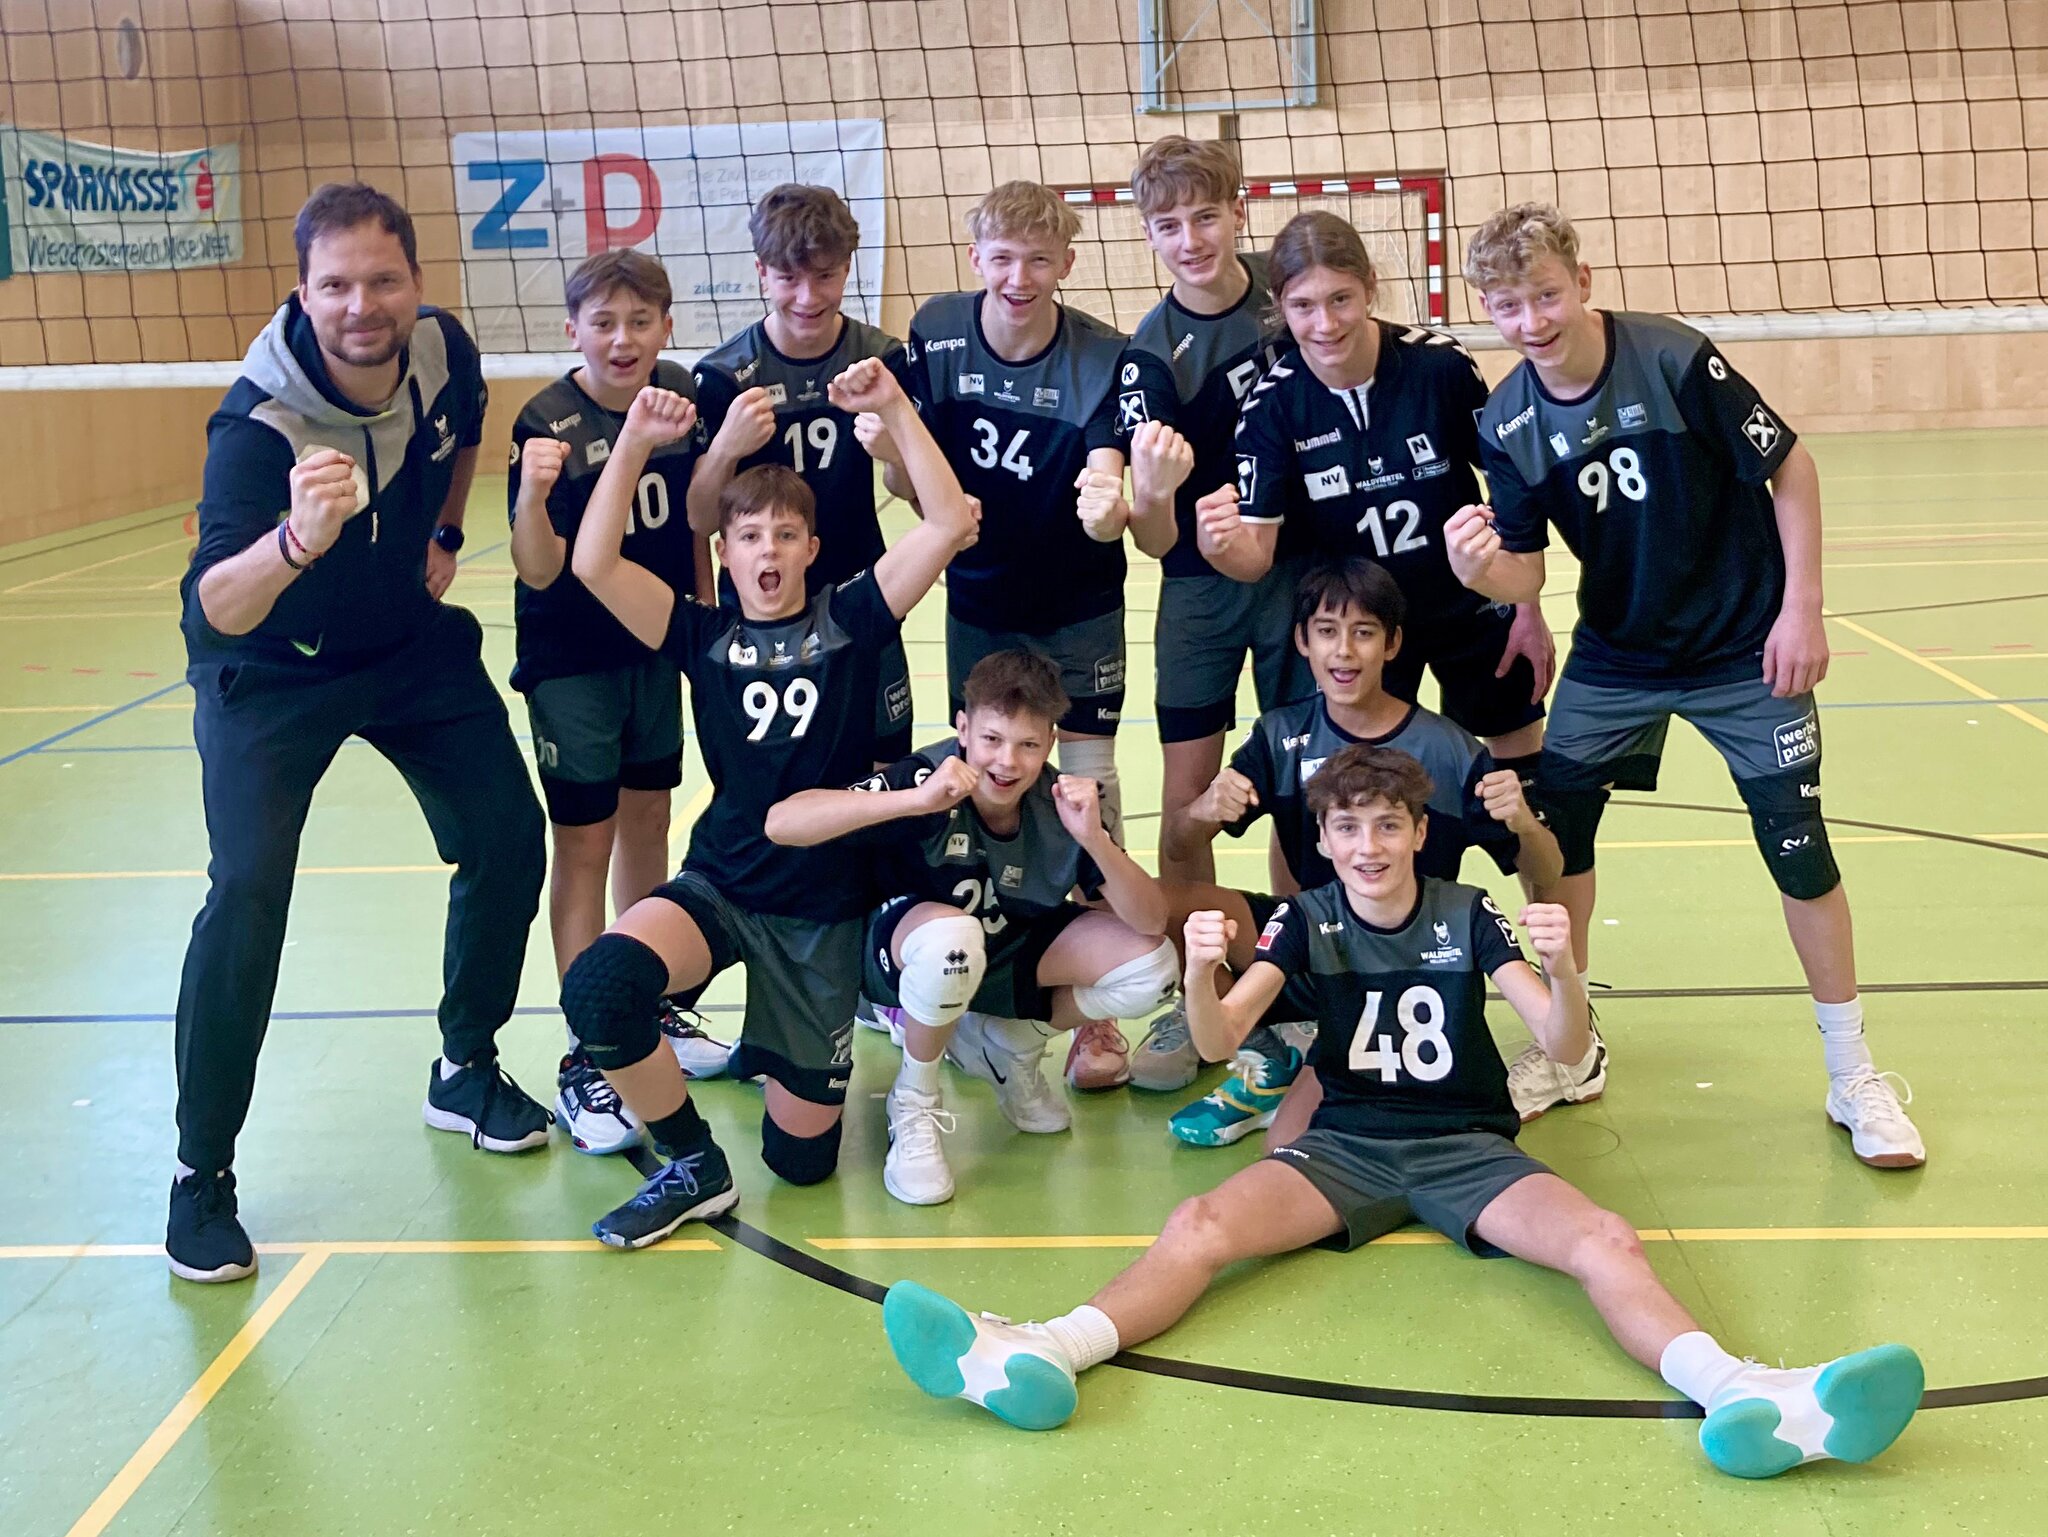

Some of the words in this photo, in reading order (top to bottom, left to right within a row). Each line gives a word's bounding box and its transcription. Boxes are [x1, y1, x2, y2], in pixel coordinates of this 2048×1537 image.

[25, 159, 180, 211] SPARKASSE
[924, 337, 966, 352] Kempa
[769, 388, 782, 397] NV
[969, 376, 983, 386] NV
[1495, 404, 1535, 439] Kempa
[784, 417, 838, 473] 19
[970, 417, 1034, 481] 34
[1294, 427, 1342, 452] hummel
[1410, 437, 1428, 454] N
[1320, 472, 1341, 486] NV
[1355, 472, 1405, 490] WALDVIERTEL
[1577, 447, 1647, 514] 98
[1356, 499, 1429, 558] 12
[742, 678, 819, 742] 99
[1781, 737, 1816, 763] profi
[951, 837, 965, 847] NV
[952, 877, 1009, 935] 25
[1348, 985, 1453, 1083] 48
